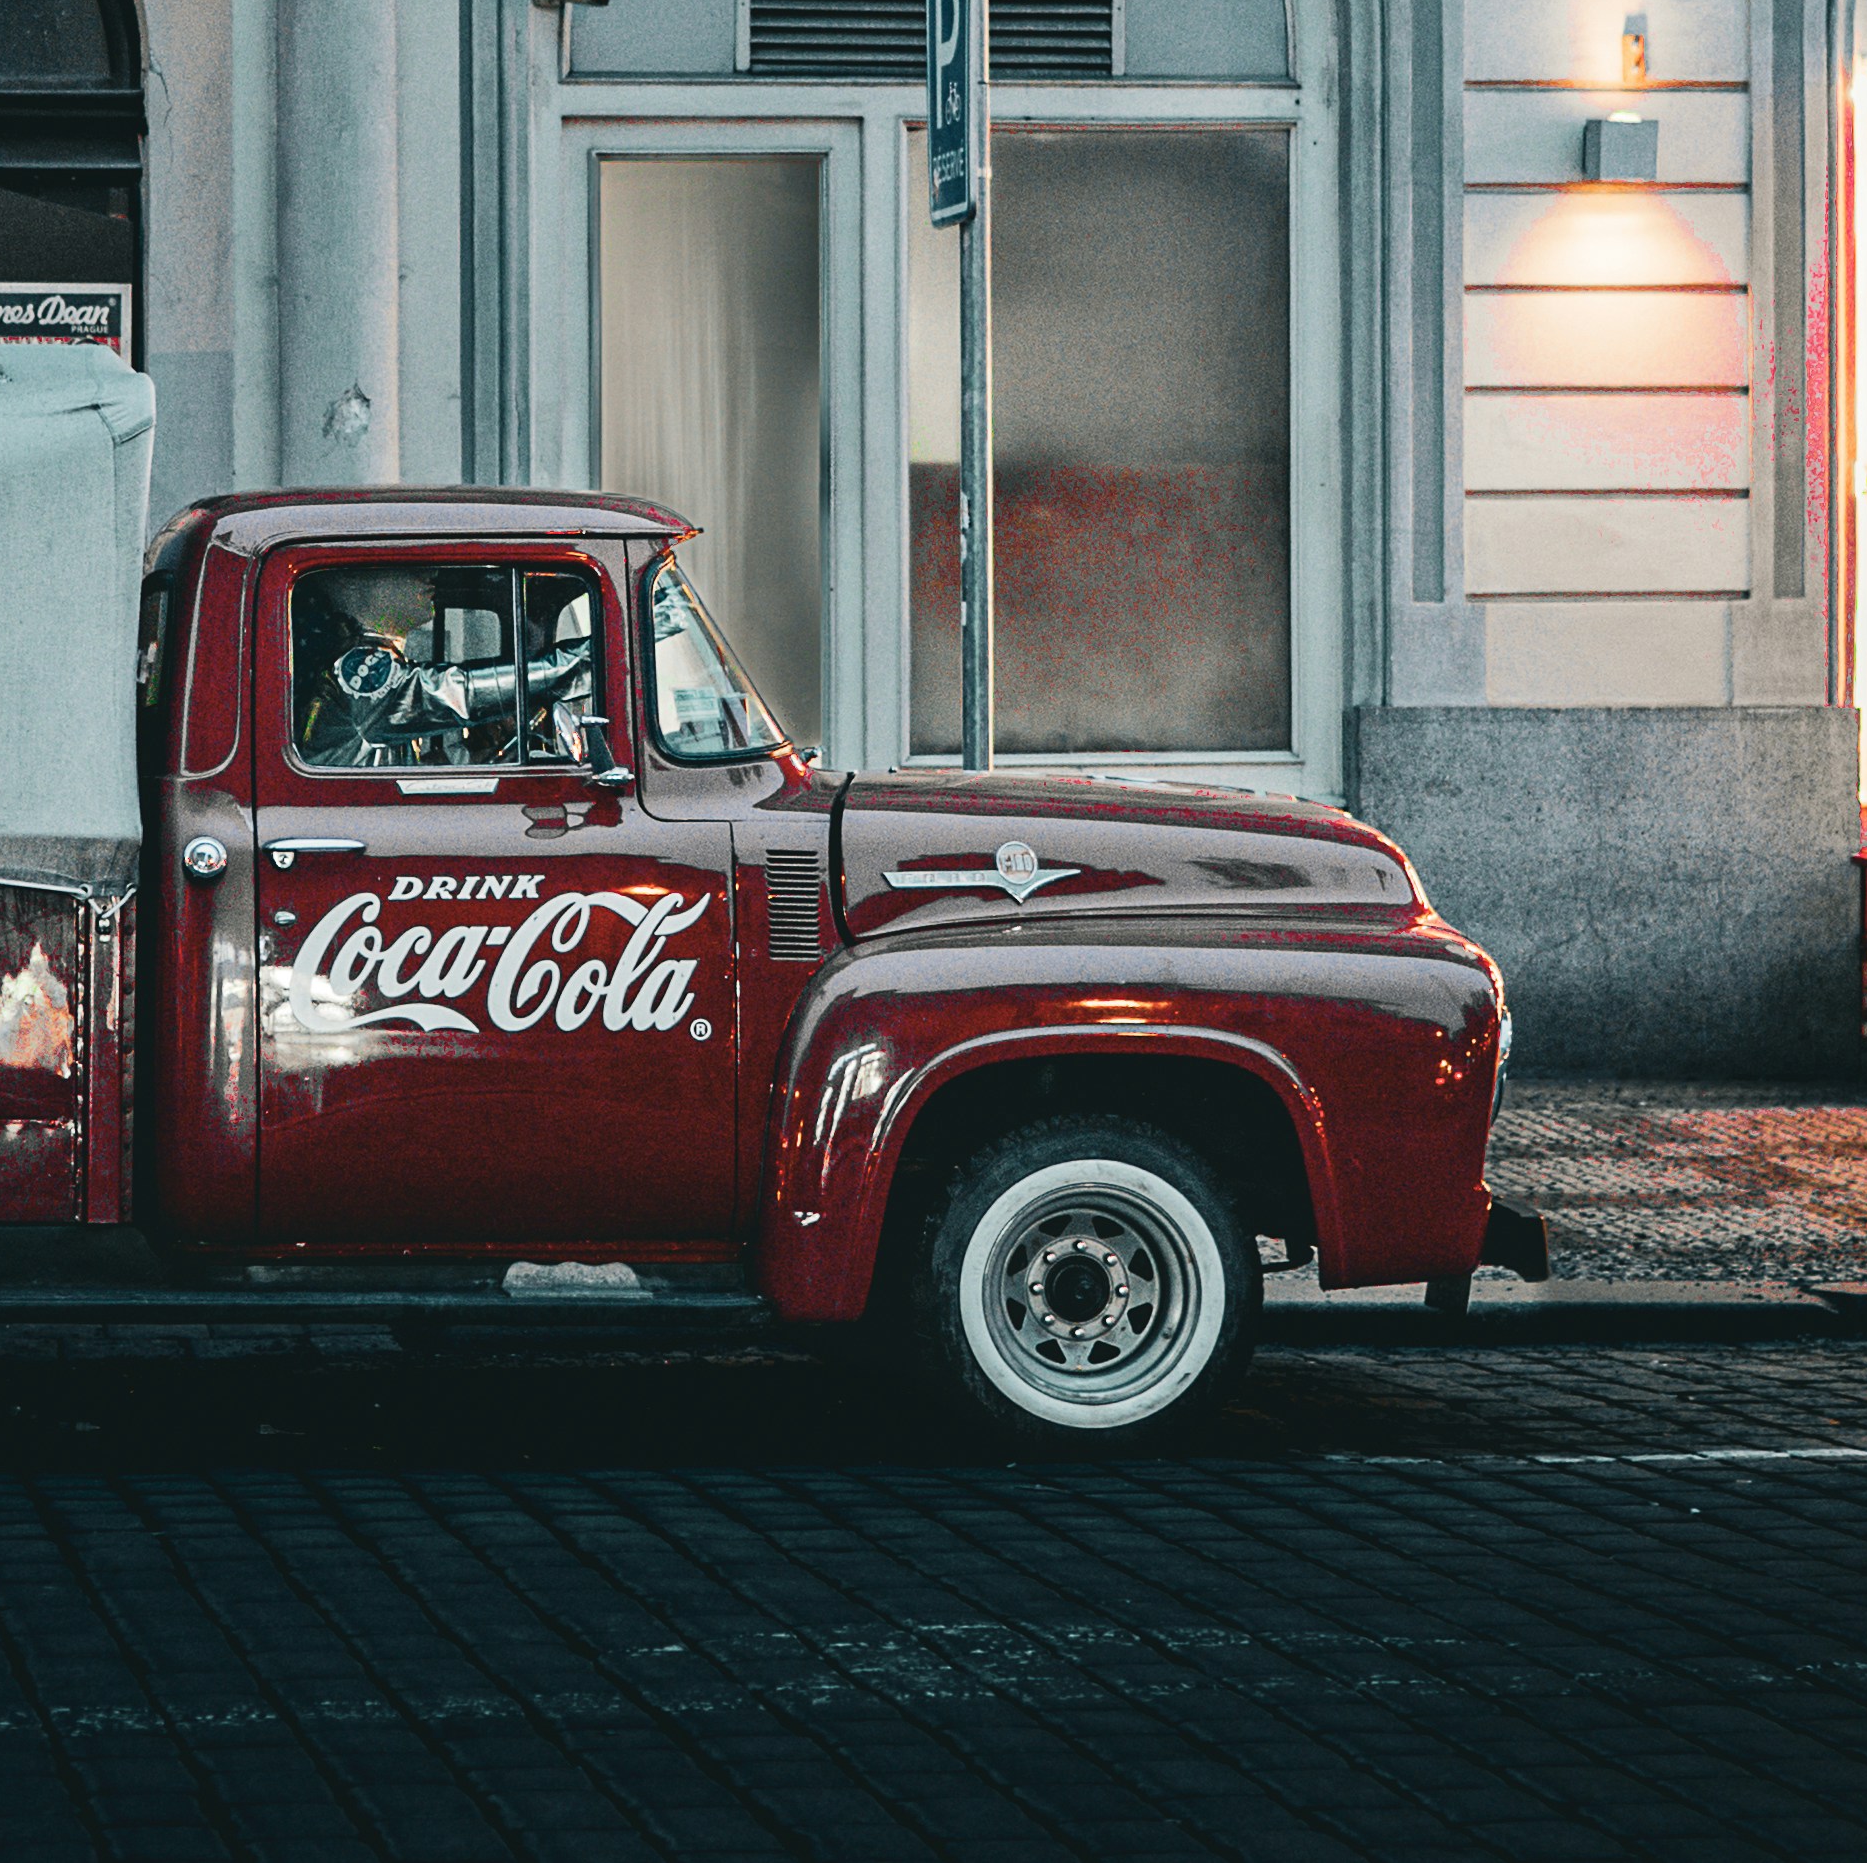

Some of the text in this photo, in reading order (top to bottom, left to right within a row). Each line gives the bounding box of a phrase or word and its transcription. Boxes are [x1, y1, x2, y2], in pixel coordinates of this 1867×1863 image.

[36, 295, 110, 325] Dean
[71, 325, 110, 334] PRAGUE
[387, 874, 546, 901] DRINK
[289, 891, 711, 1034] Coca-Cola
